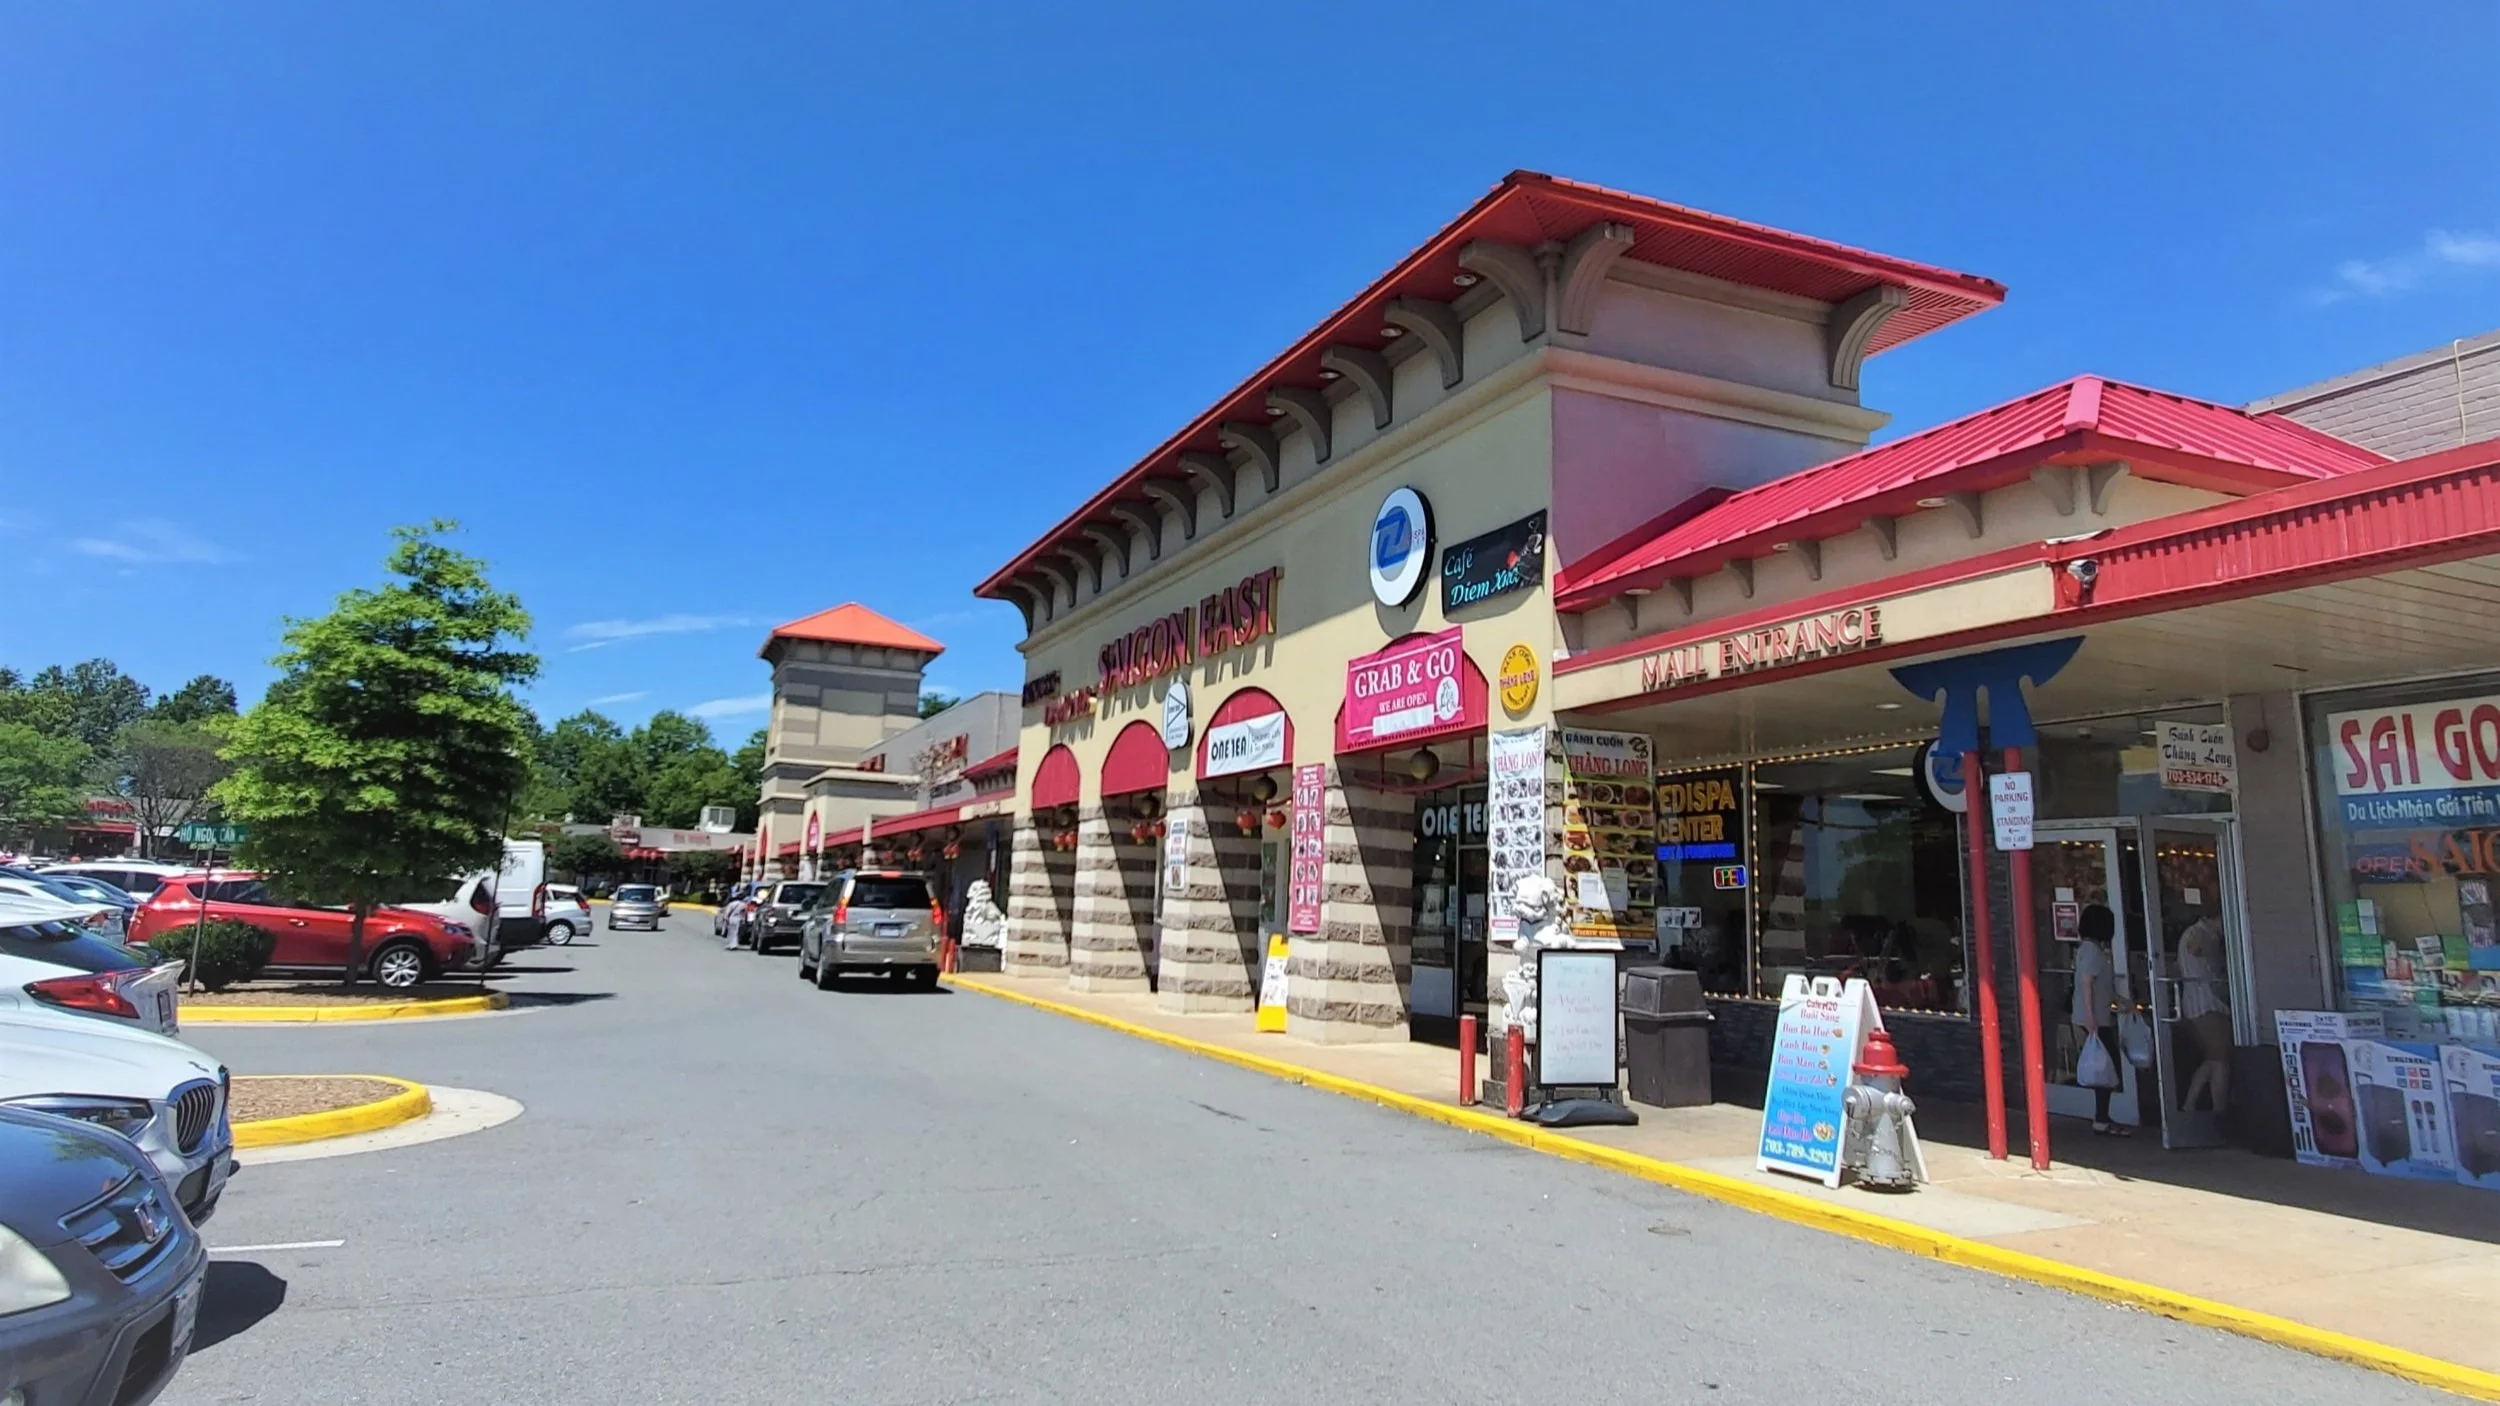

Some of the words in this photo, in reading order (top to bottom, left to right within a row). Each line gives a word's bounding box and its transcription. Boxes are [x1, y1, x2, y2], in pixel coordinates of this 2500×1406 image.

[1098, 606, 1197, 696] SAIGON
[1199, 566, 1285, 657] EAST
[1642, 645, 1709, 693] MALL
[1719, 605, 1883, 673] ENTRANCE
[1354, 662, 1402, 699] GRAB
[1406, 659, 1423, 685] &
[1426, 647, 1455, 680] GO
[1406, 691, 1428, 707] OPEN
[2340, 714, 2421, 793] SAI
[1614, 758, 1649, 777] LONG
[2004, 780, 2016, 791] NO
[1656, 779, 1737, 814] EDISPA
[1994, 791, 2029, 803] PARKING
[1657, 815, 1724, 842] CENTER
[1996, 815, 2031, 828] STANDING
[2356, 855, 2423, 874] OPEN
[1714, 868, 1746, 886] OPEN
